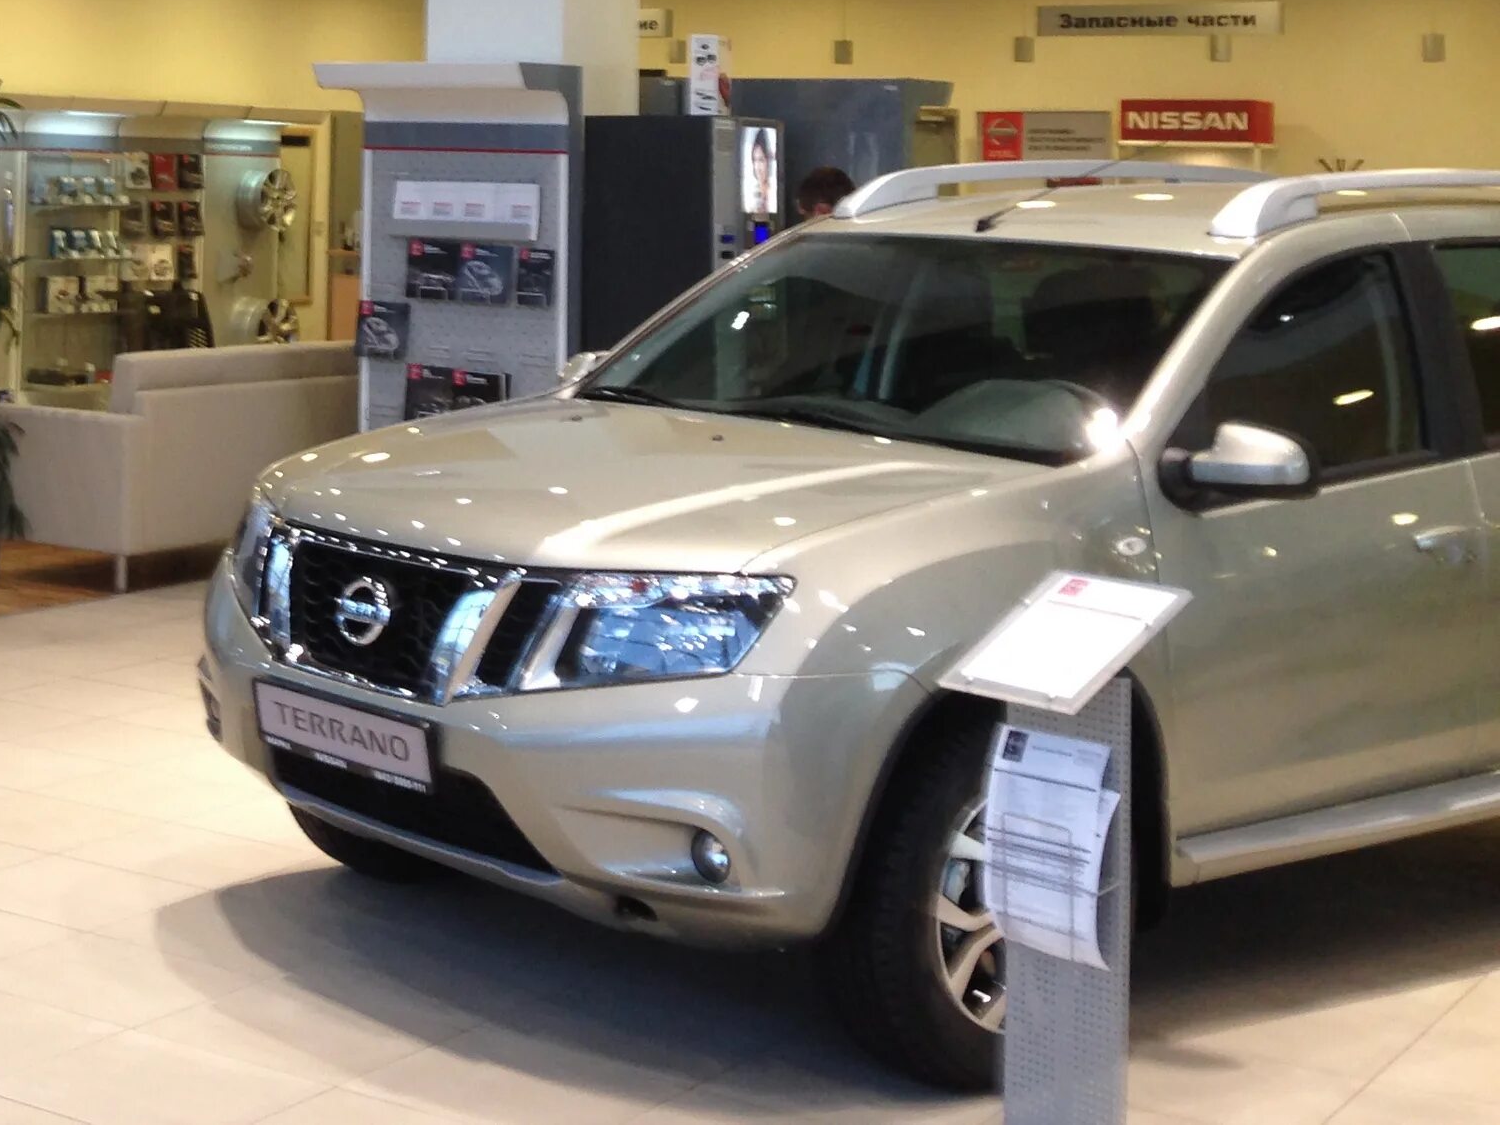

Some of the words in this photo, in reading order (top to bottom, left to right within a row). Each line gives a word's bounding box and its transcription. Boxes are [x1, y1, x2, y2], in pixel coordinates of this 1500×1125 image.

[1059, 13, 1179, 29] Запасные
[1187, 14, 1257, 28] части
[1127, 111, 1250, 131] NISSAN
[273, 700, 410, 763] TERRANO
